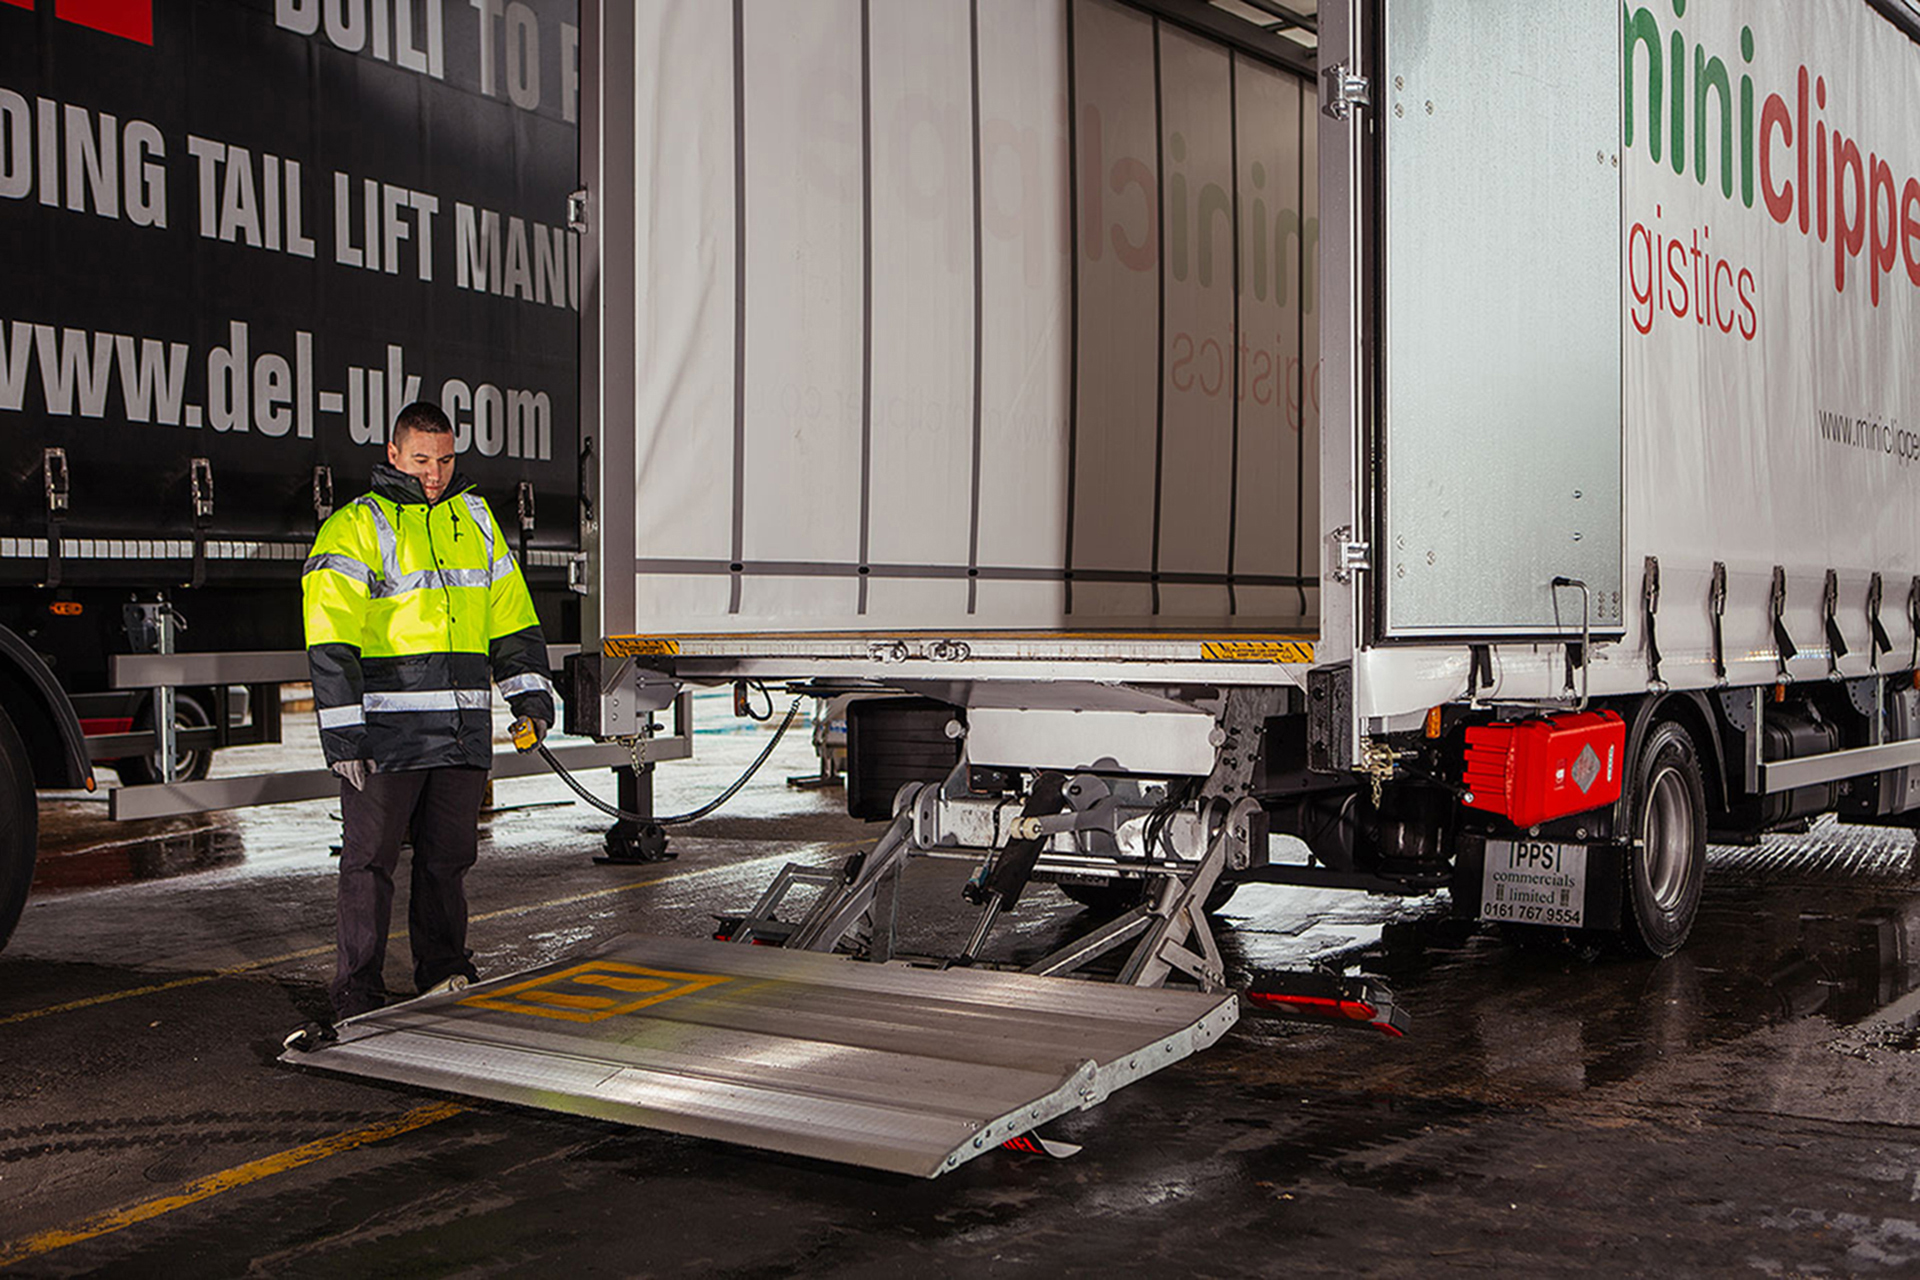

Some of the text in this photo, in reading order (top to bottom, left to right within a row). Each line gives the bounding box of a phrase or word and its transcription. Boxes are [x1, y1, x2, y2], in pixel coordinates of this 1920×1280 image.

[275, 0, 444, 80] ILT
[469, 0, 541, 111] TO
[0, 87, 167, 229] DING
[187, 134, 316, 259] TAIL
[334, 171, 439, 282] LIFT
[1629, 204, 1757, 341] gistics
[0, 319, 551, 461] ww.del-ukcom
[1484, 902, 1581, 924] 0161 767 9554
[1493, 871, 1576, 888] commercials
[1509, 887, 1555, 905] limited
